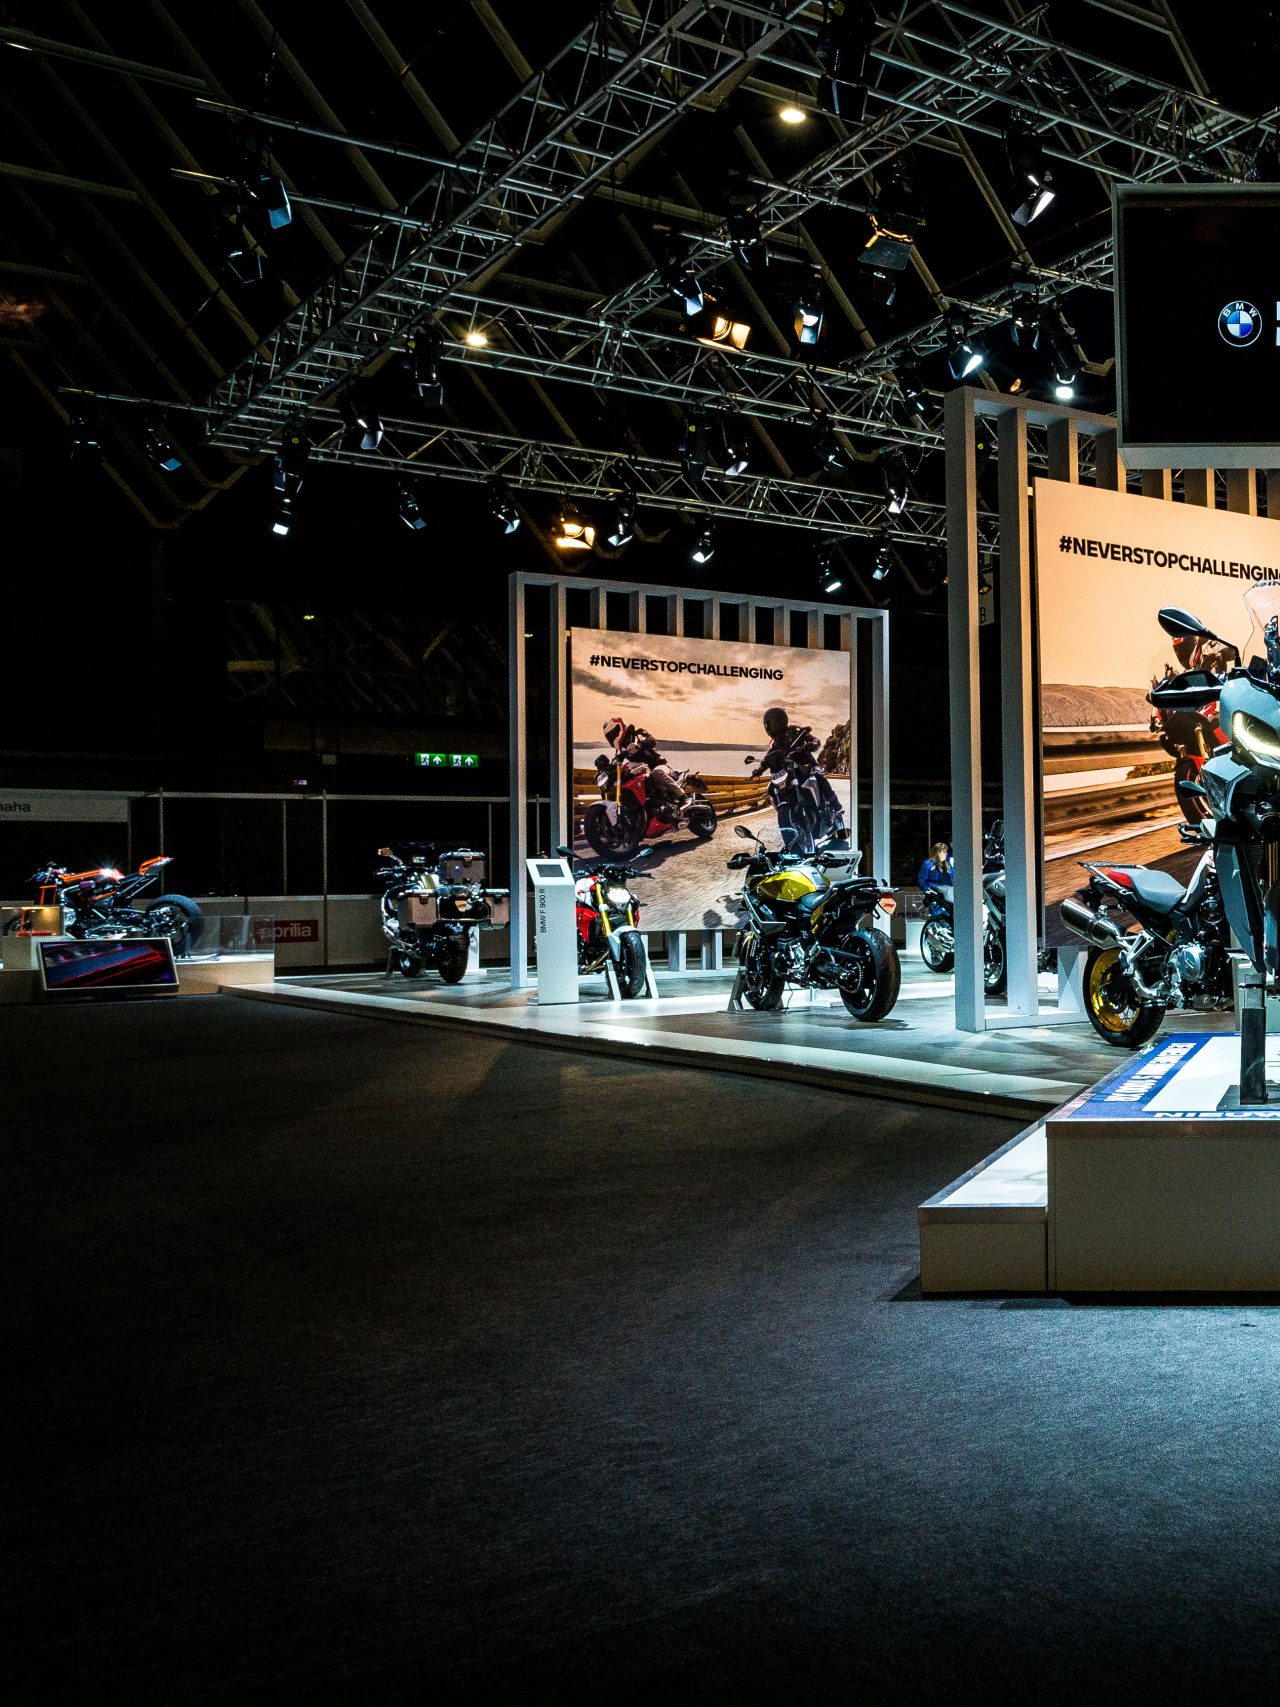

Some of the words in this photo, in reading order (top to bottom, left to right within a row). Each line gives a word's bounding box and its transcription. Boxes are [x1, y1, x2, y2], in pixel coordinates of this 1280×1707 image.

[1222, 302, 1258, 318] BMW
[589, 654, 784, 681] #NEVERSTOPCHALLENGING
[539, 915, 547, 934] BMW
